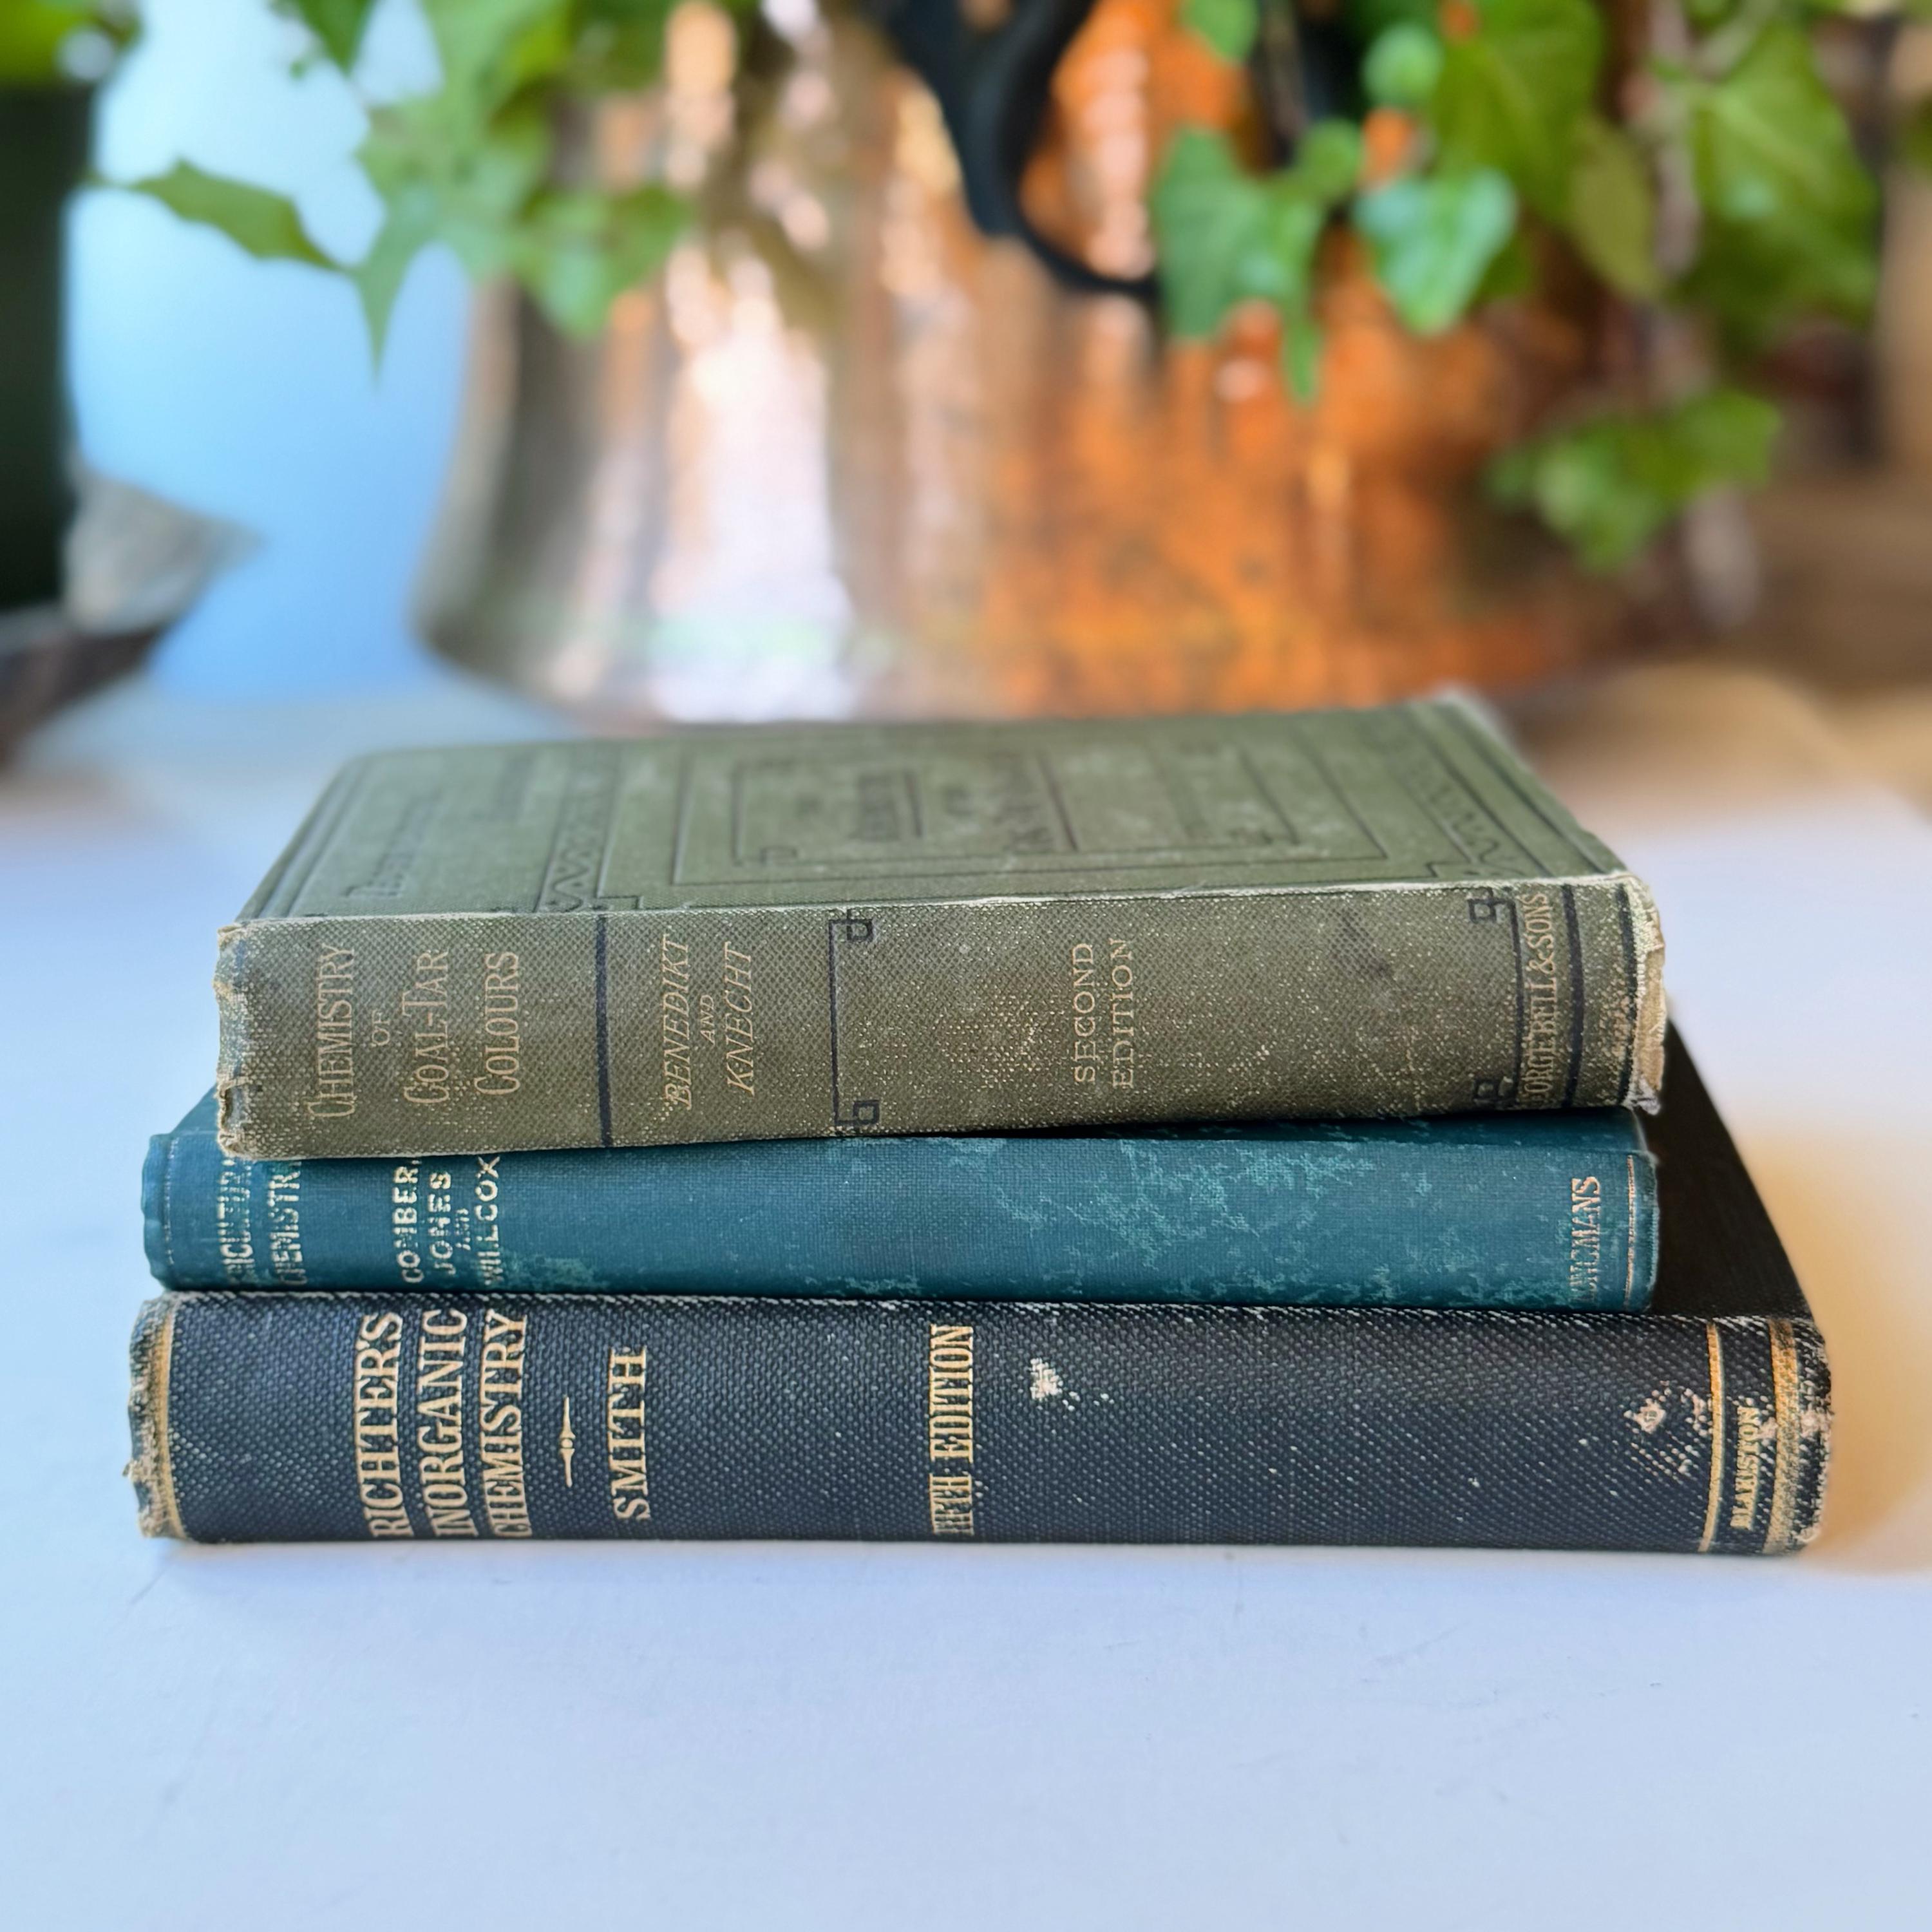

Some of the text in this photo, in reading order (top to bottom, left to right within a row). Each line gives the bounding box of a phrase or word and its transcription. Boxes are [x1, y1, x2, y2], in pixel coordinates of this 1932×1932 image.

[305, 943, 356, 1117] CHEMISTRY
[372, 1009, 390, 1046] OF
[402, 951, 450, 1103] COAL-TAR
[474, 952, 520, 1094] COLOURS
[662, 934, 692, 1109] BENEDIKT
[700, 994, 715, 1045] AND
[724, 942, 754, 1095] KNECHT
[1072, 943, 1096, 1083] SECOND
[1110, 938, 1134, 1088] EDITION
[428, 1171, 456, 1274] JONES
[354, 1311, 414, 1537] RICHTER'S
[417, 1309, 478, 1535] INORGANIC
[480, 1309, 532, 1537] CHEMISTRY
[608, 1348, 650, 1520] SMITH
[929, 1324, 974, 1535] FIFTH EDITION
[1730, 1405, 1758, 1531] BLAKISTON
